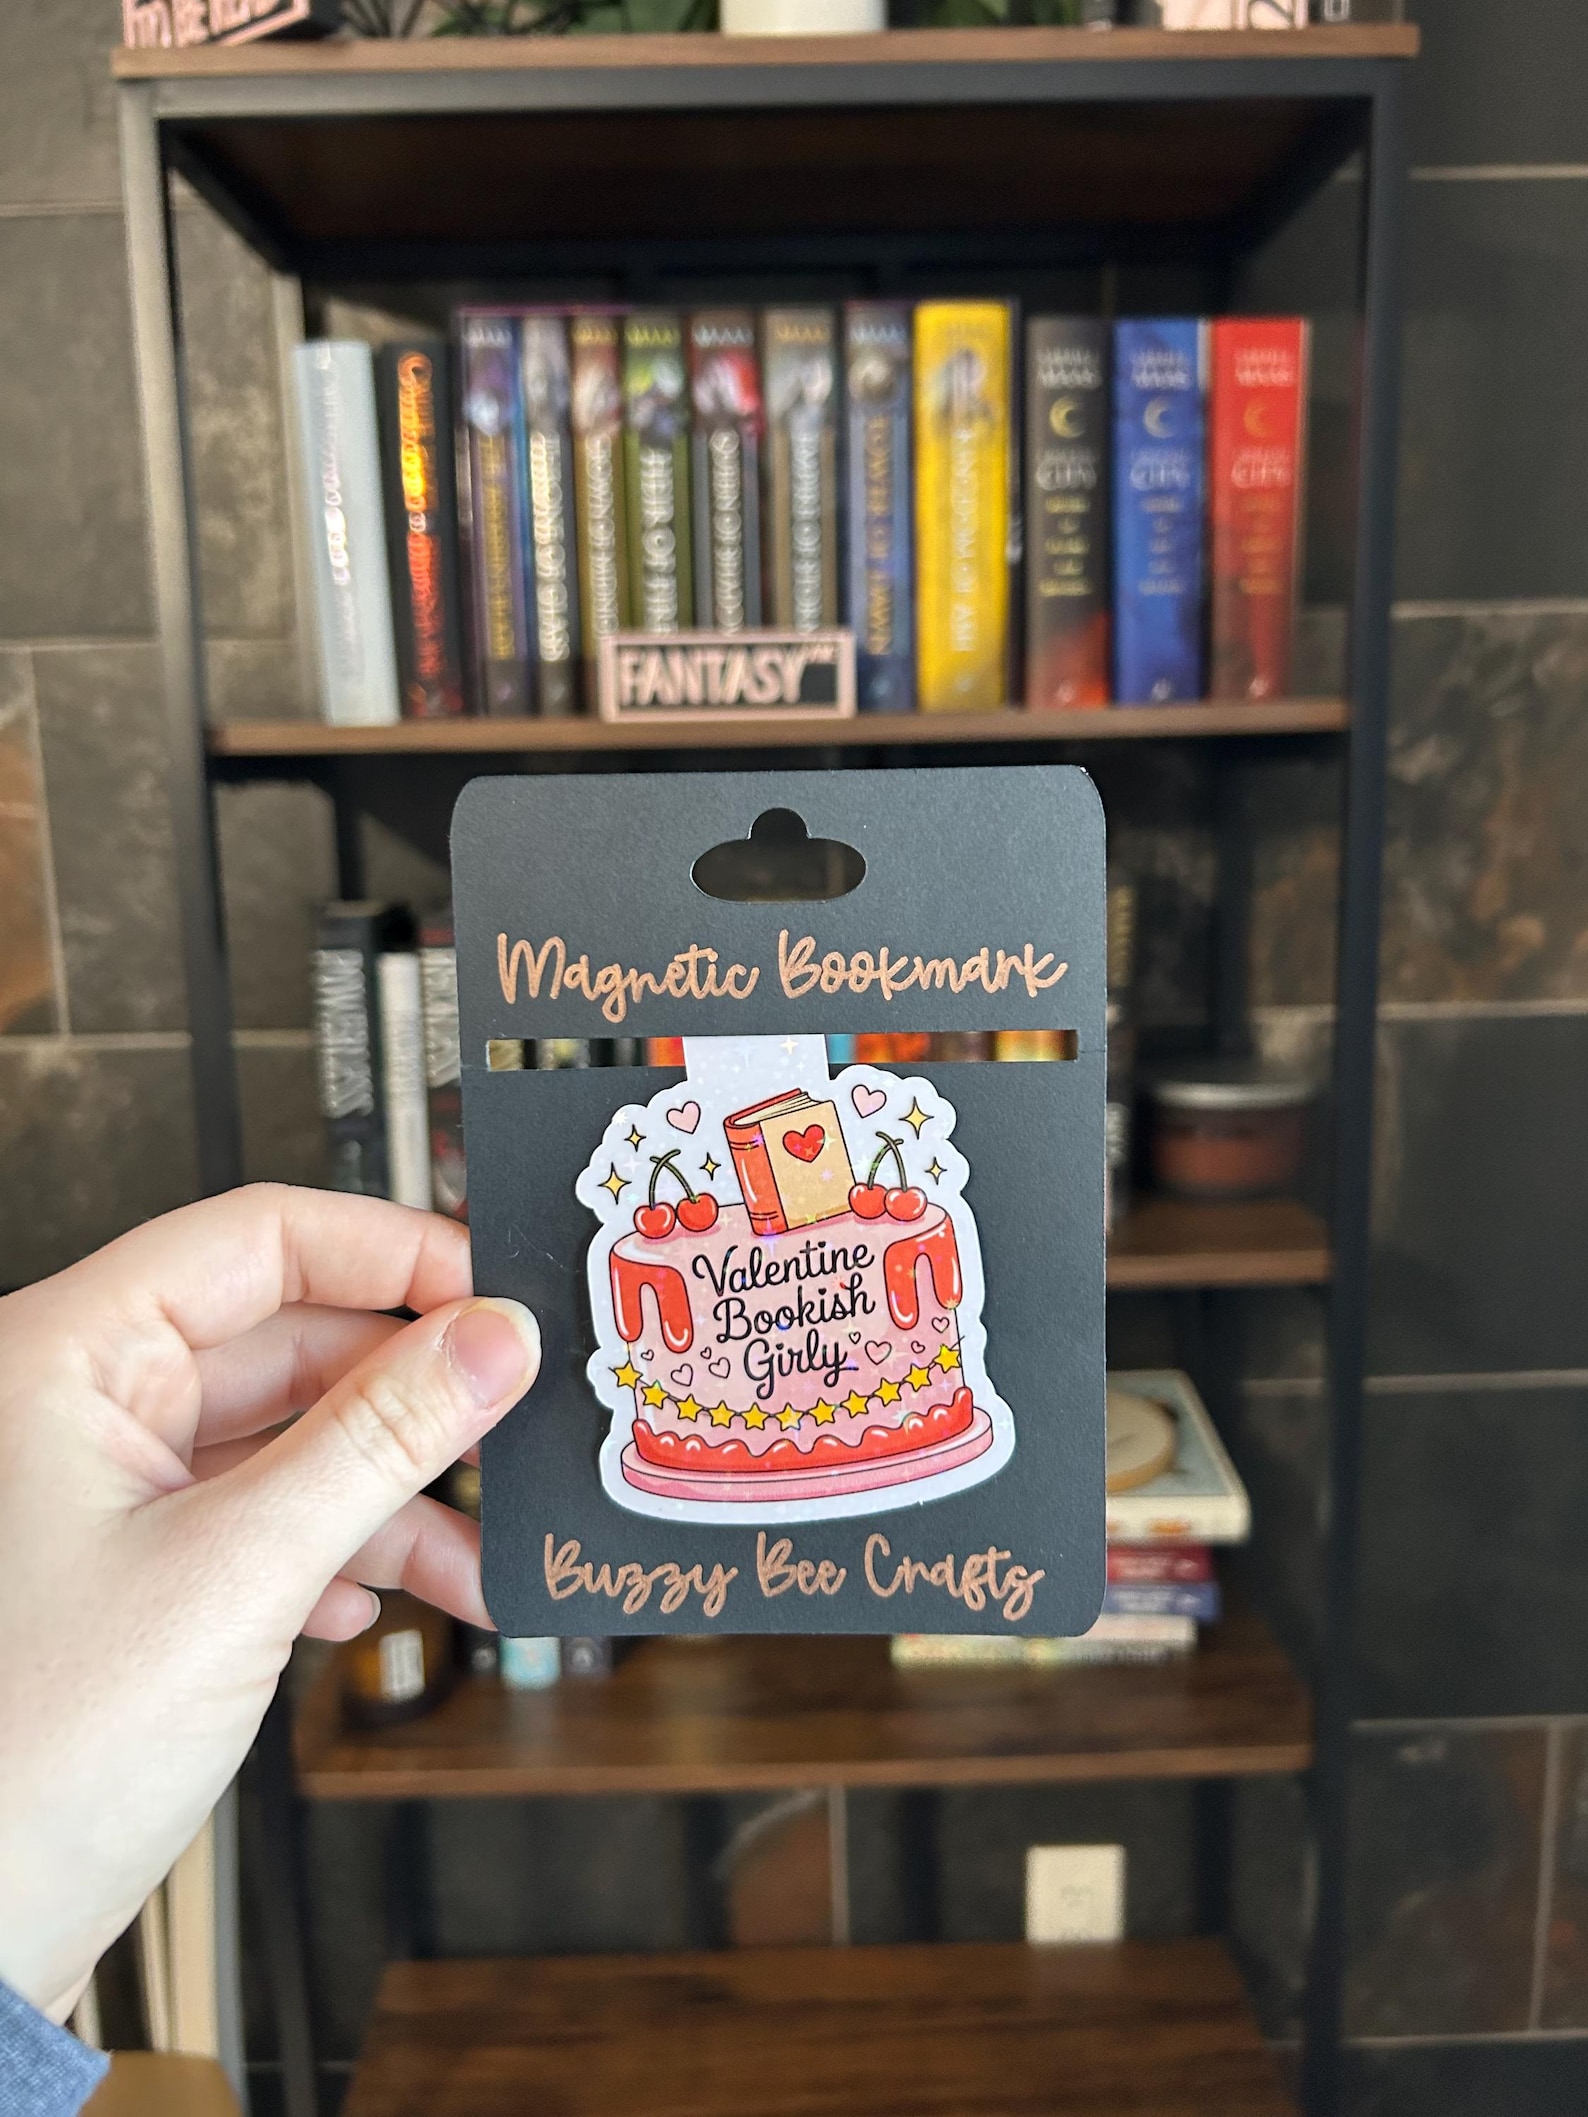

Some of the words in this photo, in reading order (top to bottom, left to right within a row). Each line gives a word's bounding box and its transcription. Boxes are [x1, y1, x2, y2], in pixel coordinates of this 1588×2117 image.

[619, 643, 810, 706] FANTASY
[497, 931, 761, 1024] Magnetic
[778, 929, 1069, 1001] Bookmark
[692, 1240, 875, 1297] Valentine
[713, 1273, 876, 1343] Bookish
[743, 1330, 859, 1400] Girly
[544, 1532, 738, 1618] Buzzy
[756, 1531, 847, 1598] Bee
[864, 1533, 1046, 1622] Crafts
